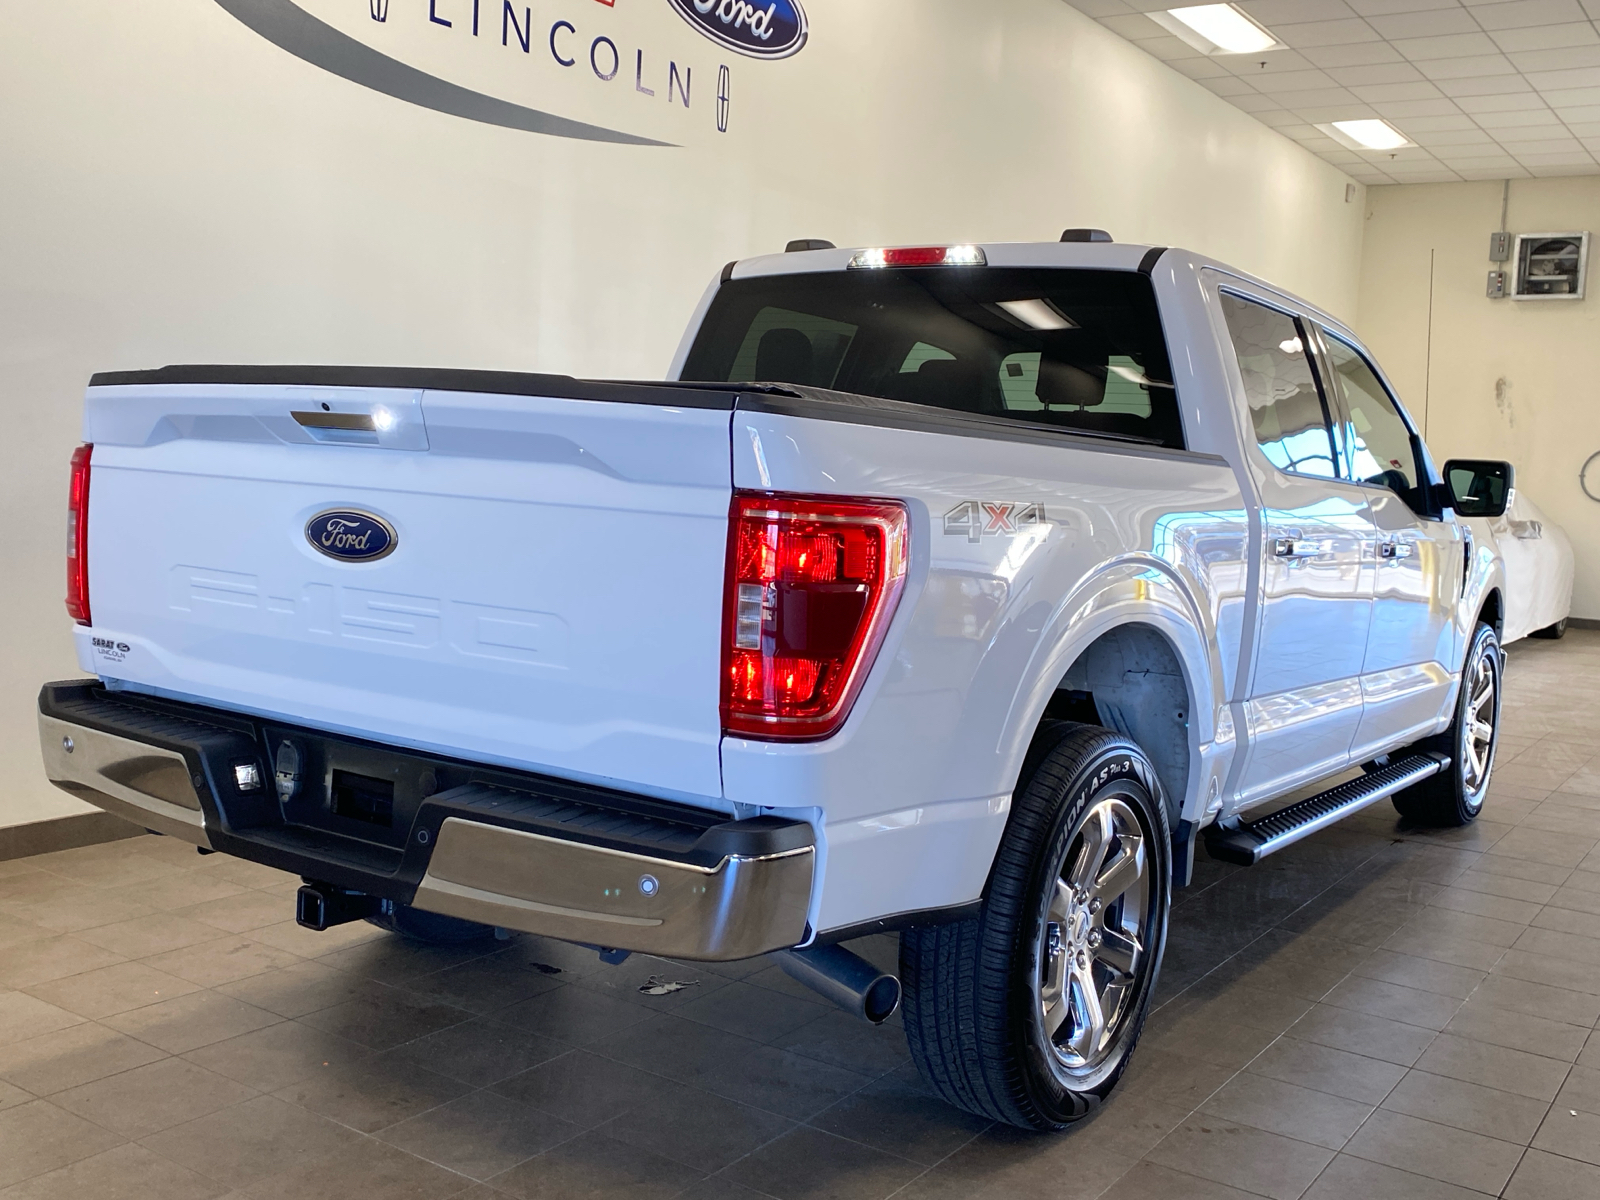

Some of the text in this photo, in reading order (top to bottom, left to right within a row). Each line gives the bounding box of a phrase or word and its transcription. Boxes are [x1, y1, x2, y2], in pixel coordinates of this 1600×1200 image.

[321, 518, 372, 551] Ford
[168, 563, 571, 670] F-150
[97, 647, 126, 659] LINCOLN
[1090, 767, 1109, 795] AS
[1122, 761, 1130, 773] 3
